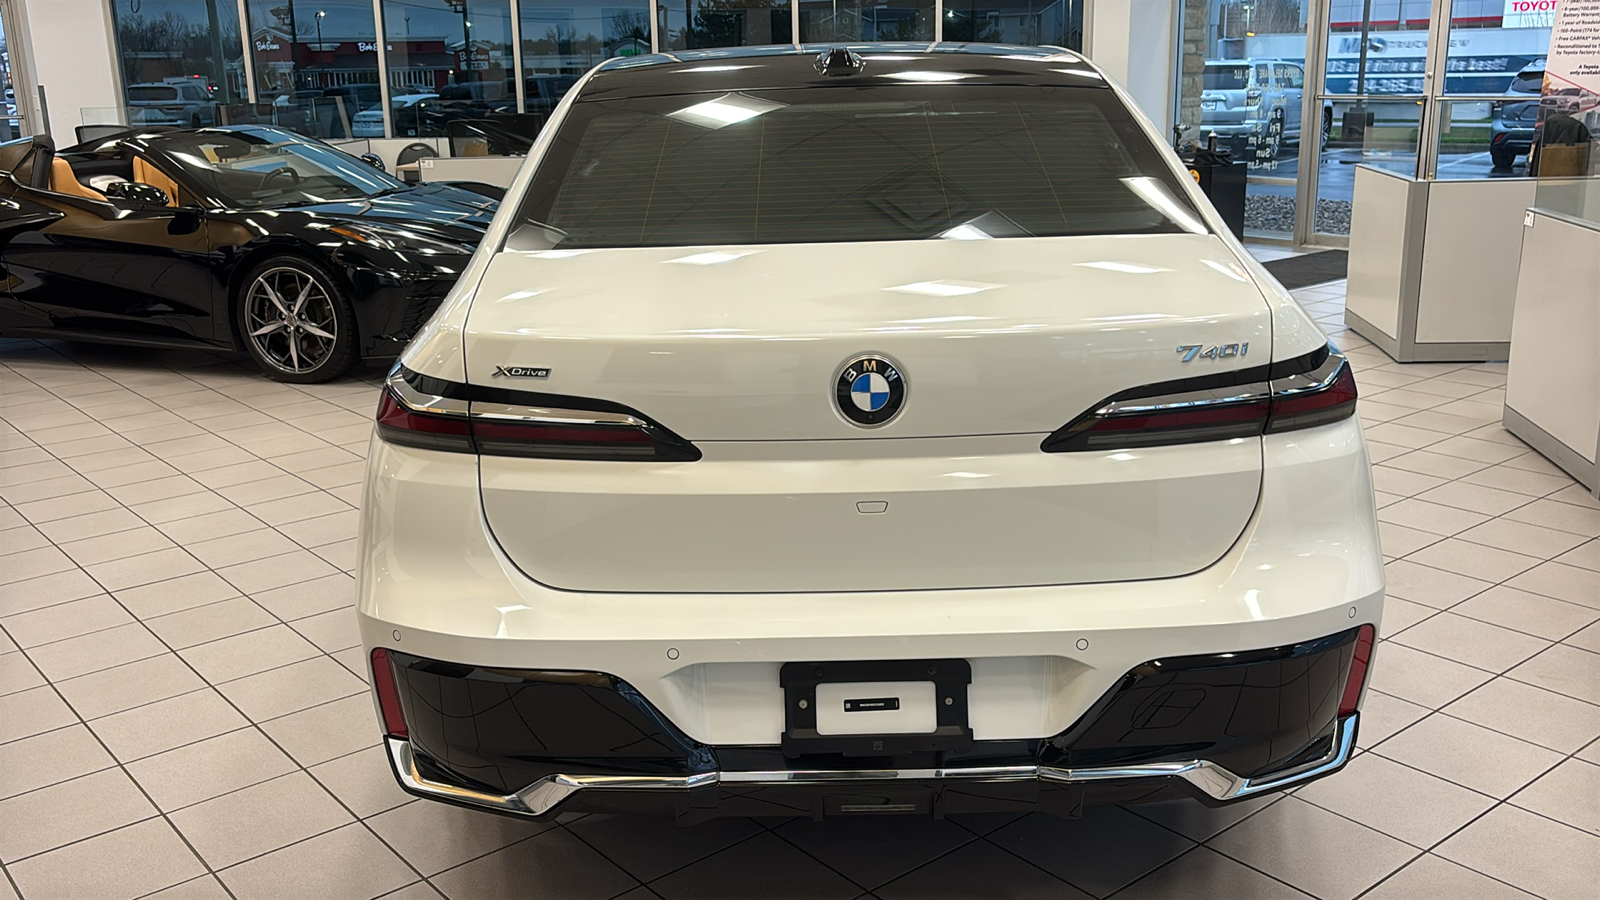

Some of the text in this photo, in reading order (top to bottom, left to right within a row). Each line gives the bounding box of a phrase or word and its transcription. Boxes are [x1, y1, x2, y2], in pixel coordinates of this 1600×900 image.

[1512, 1, 1557, 12] TOYOT
[255, 41, 280, 51] Bob Evans
[357, 42, 372, 52] Bob
[1176, 342, 1249, 363] 740i
[843, 360, 898, 383] BMW
